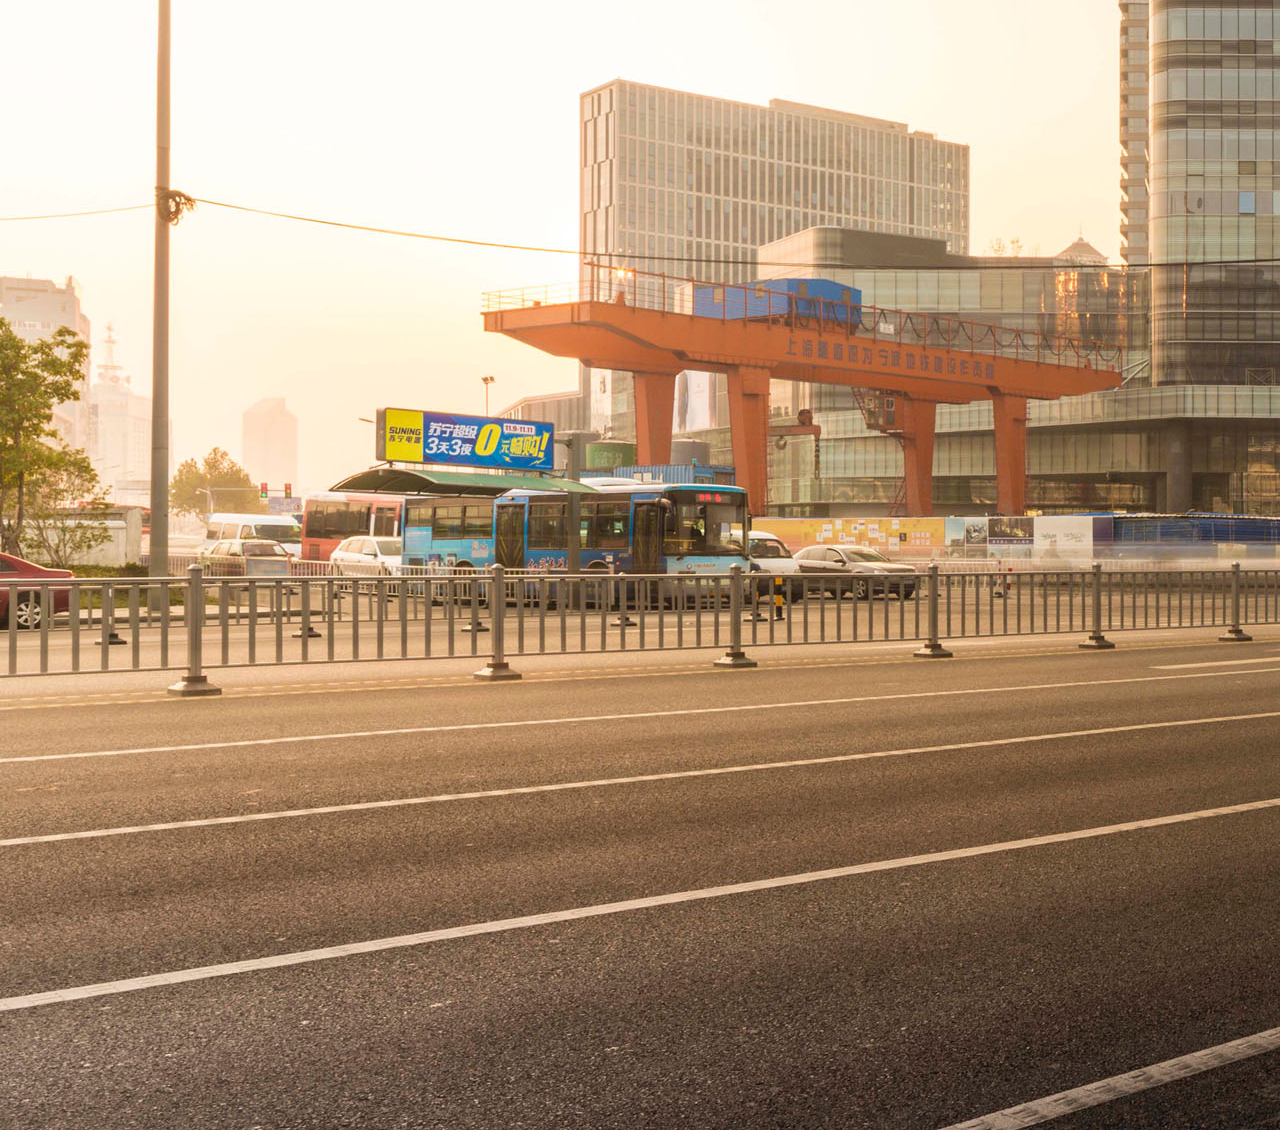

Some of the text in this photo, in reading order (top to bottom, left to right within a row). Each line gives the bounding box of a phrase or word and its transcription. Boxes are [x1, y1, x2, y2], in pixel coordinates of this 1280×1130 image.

[389, 426, 421, 436] SUNING
[428, 422, 478, 439] 苏宁超级
[425, 437, 473, 456] 3天3夜
